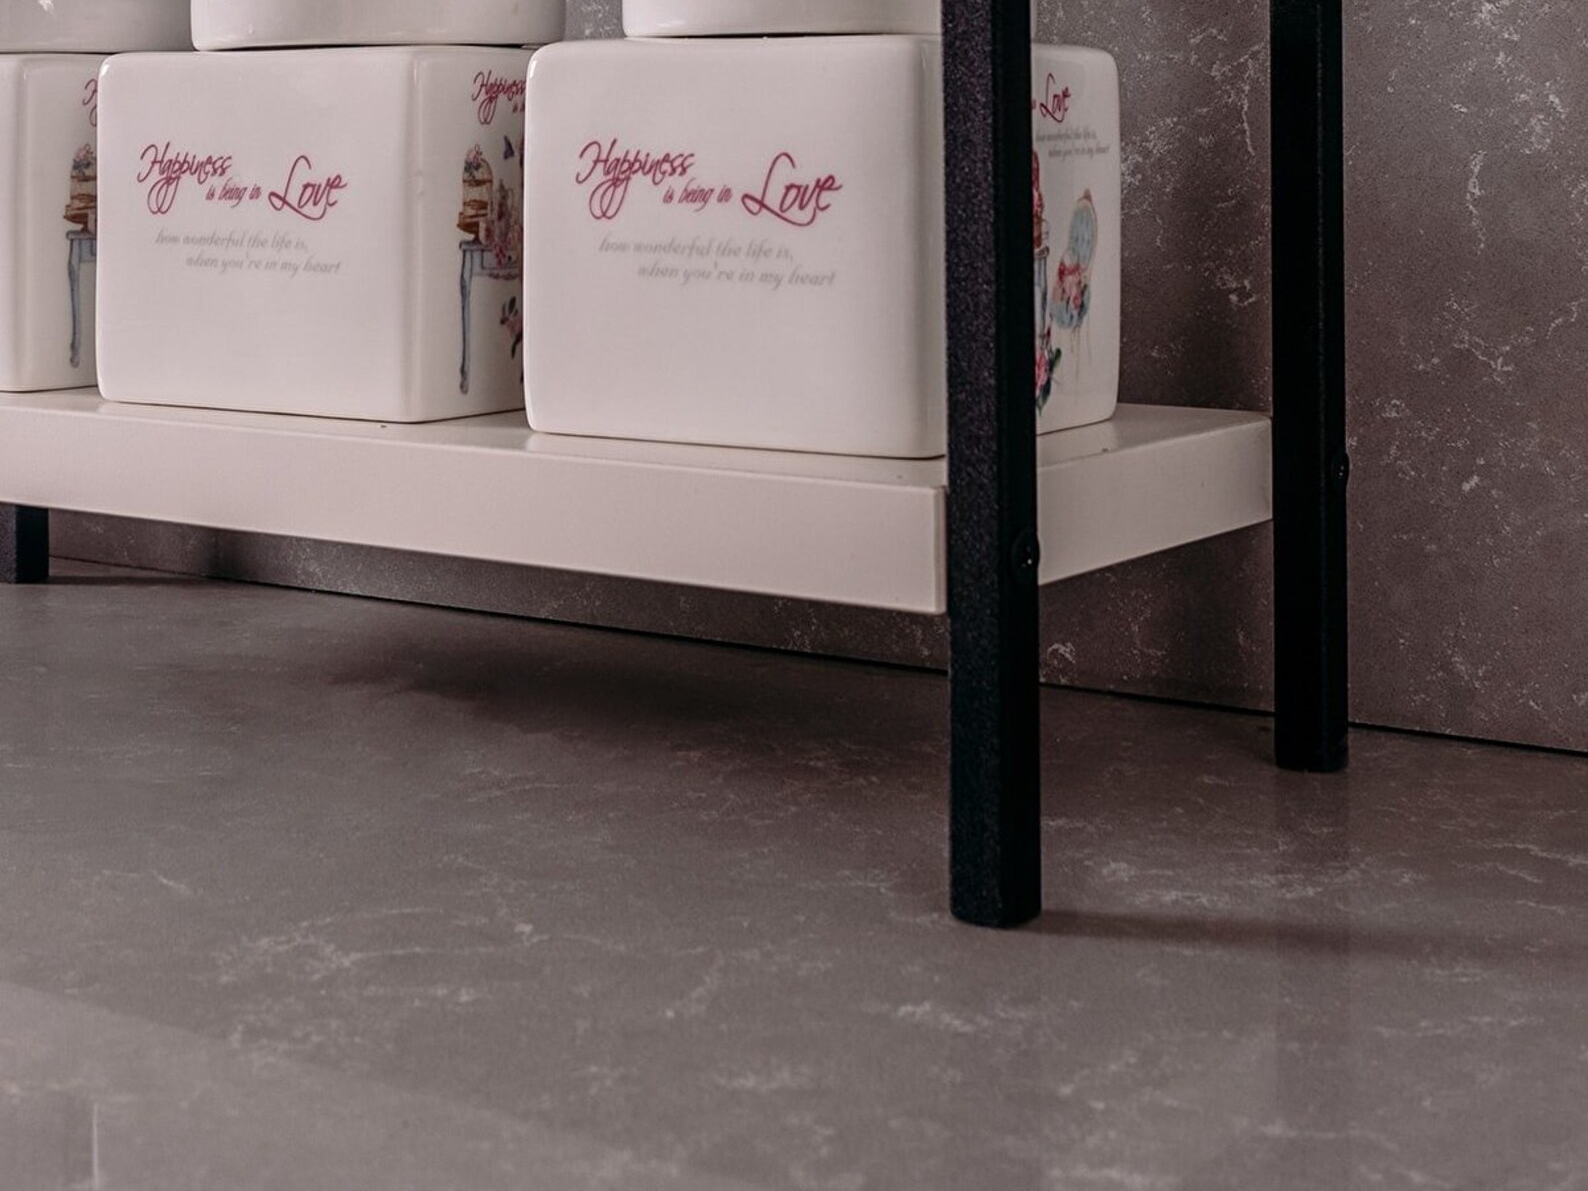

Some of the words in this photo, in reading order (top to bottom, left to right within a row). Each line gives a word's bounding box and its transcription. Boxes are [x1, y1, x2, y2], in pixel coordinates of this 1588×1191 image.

[137, 141, 232, 214] Happiness
[205, 184, 215, 201] is
[249, 184, 262, 200] in
[268, 155, 348, 221] Love
[575, 137, 696, 220] Happiness
[663, 184, 674, 204] is
[678, 177, 715, 212] being
[717, 184, 733, 203] in
[741, 152, 843, 227] Love
[247, 231, 268, 248] the
[270, 231, 292, 252] life
[633, 235, 715, 257] wonderful
[716, 236, 742, 257] the
[746, 238, 773, 262] life
[264, 258, 278, 270] in
[302, 254, 341, 273] heart
[680, 260, 736, 285] you're
[739, 267, 756, 282] in
[759, 271, 784, 290] my
[787, 264, 837, 286] heart
